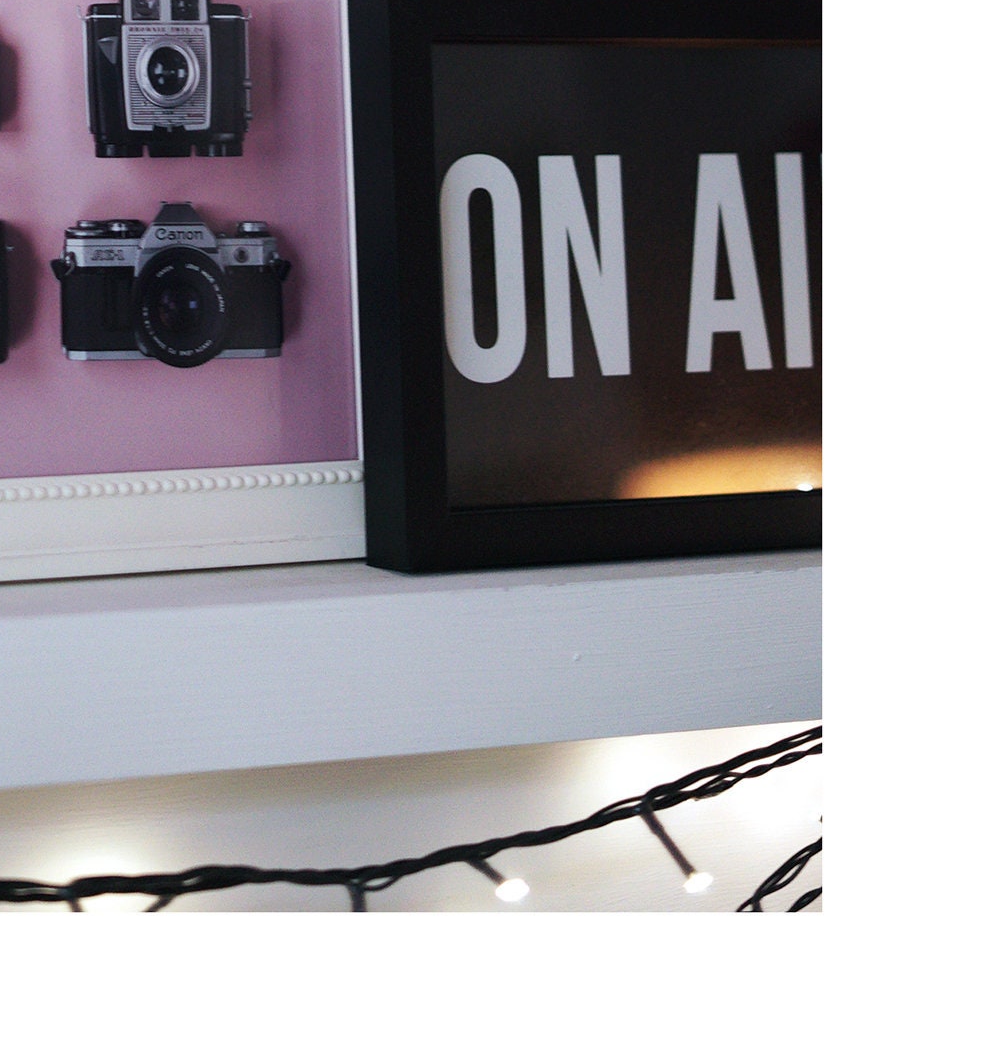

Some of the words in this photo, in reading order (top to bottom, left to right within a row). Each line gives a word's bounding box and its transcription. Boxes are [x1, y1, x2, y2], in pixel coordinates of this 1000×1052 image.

[154, 227, 204, 241] Canon
[440, 153, 632, 384] ON
[686, 151, 823, 373] AI
